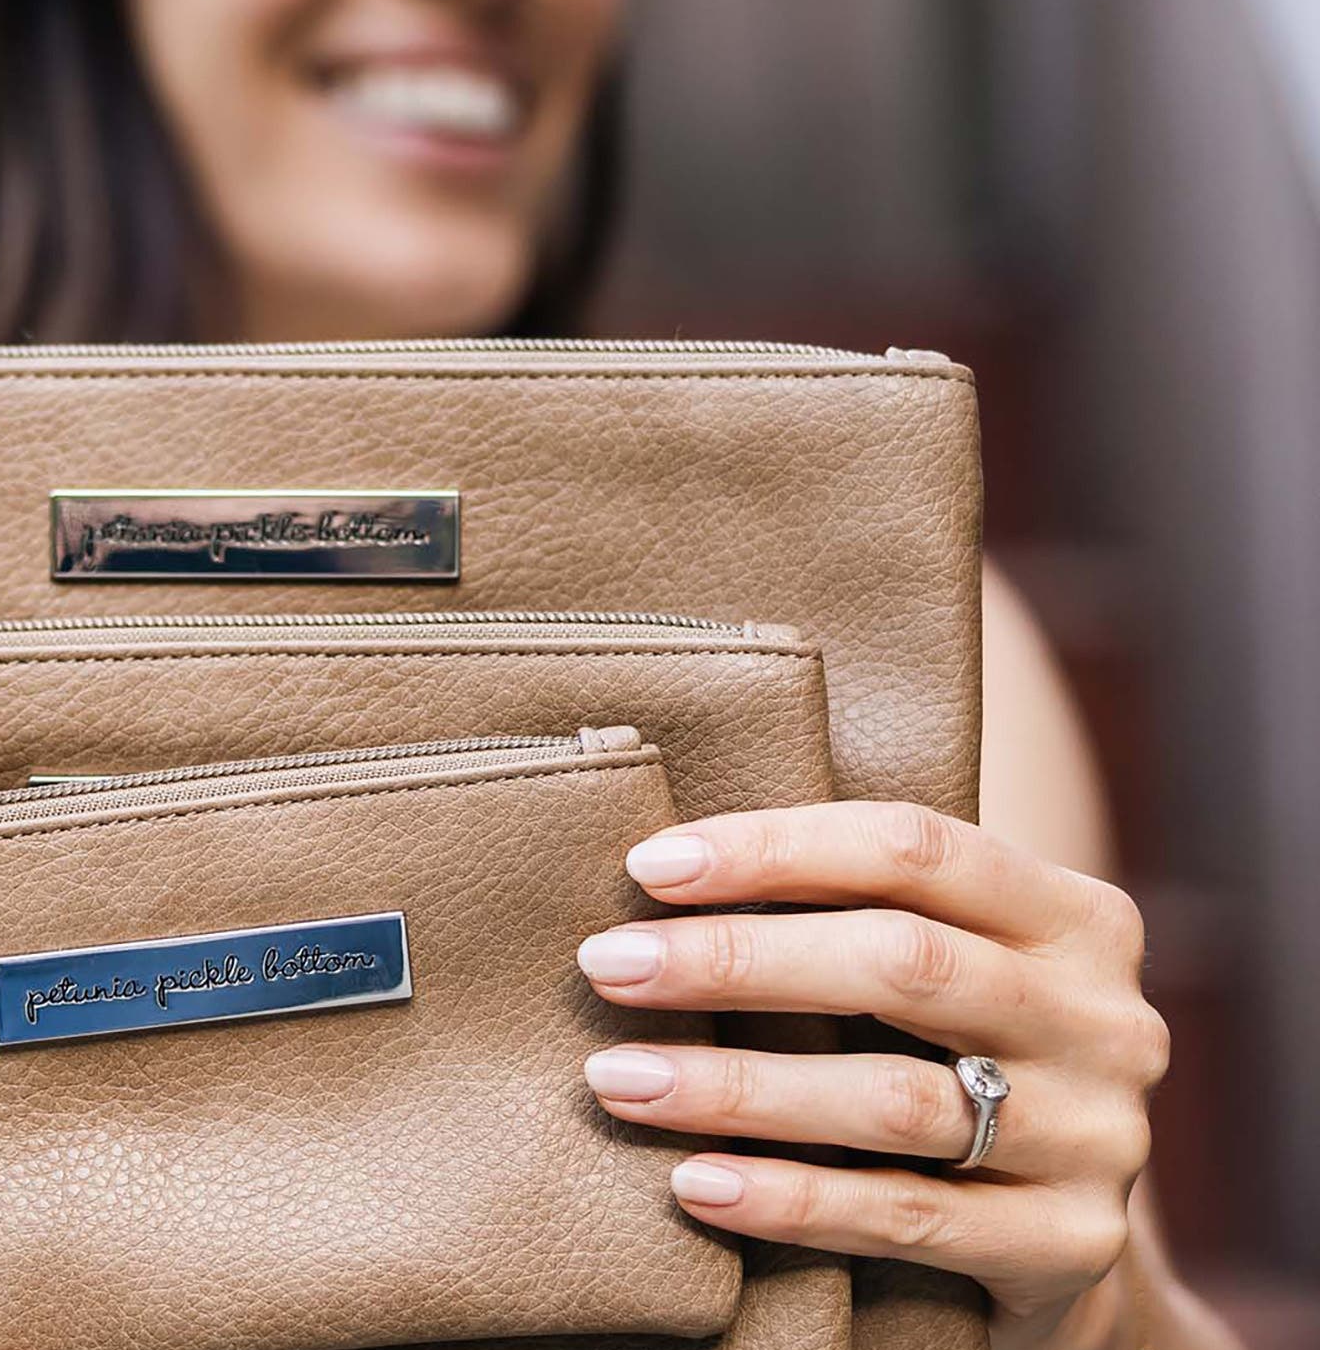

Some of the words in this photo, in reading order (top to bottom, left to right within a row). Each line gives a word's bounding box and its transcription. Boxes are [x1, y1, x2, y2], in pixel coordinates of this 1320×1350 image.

[26, 976, 147, 1024] petunia
[155, 954, 254, 1009] pickle
[262, 945, 375, 980] bottom
